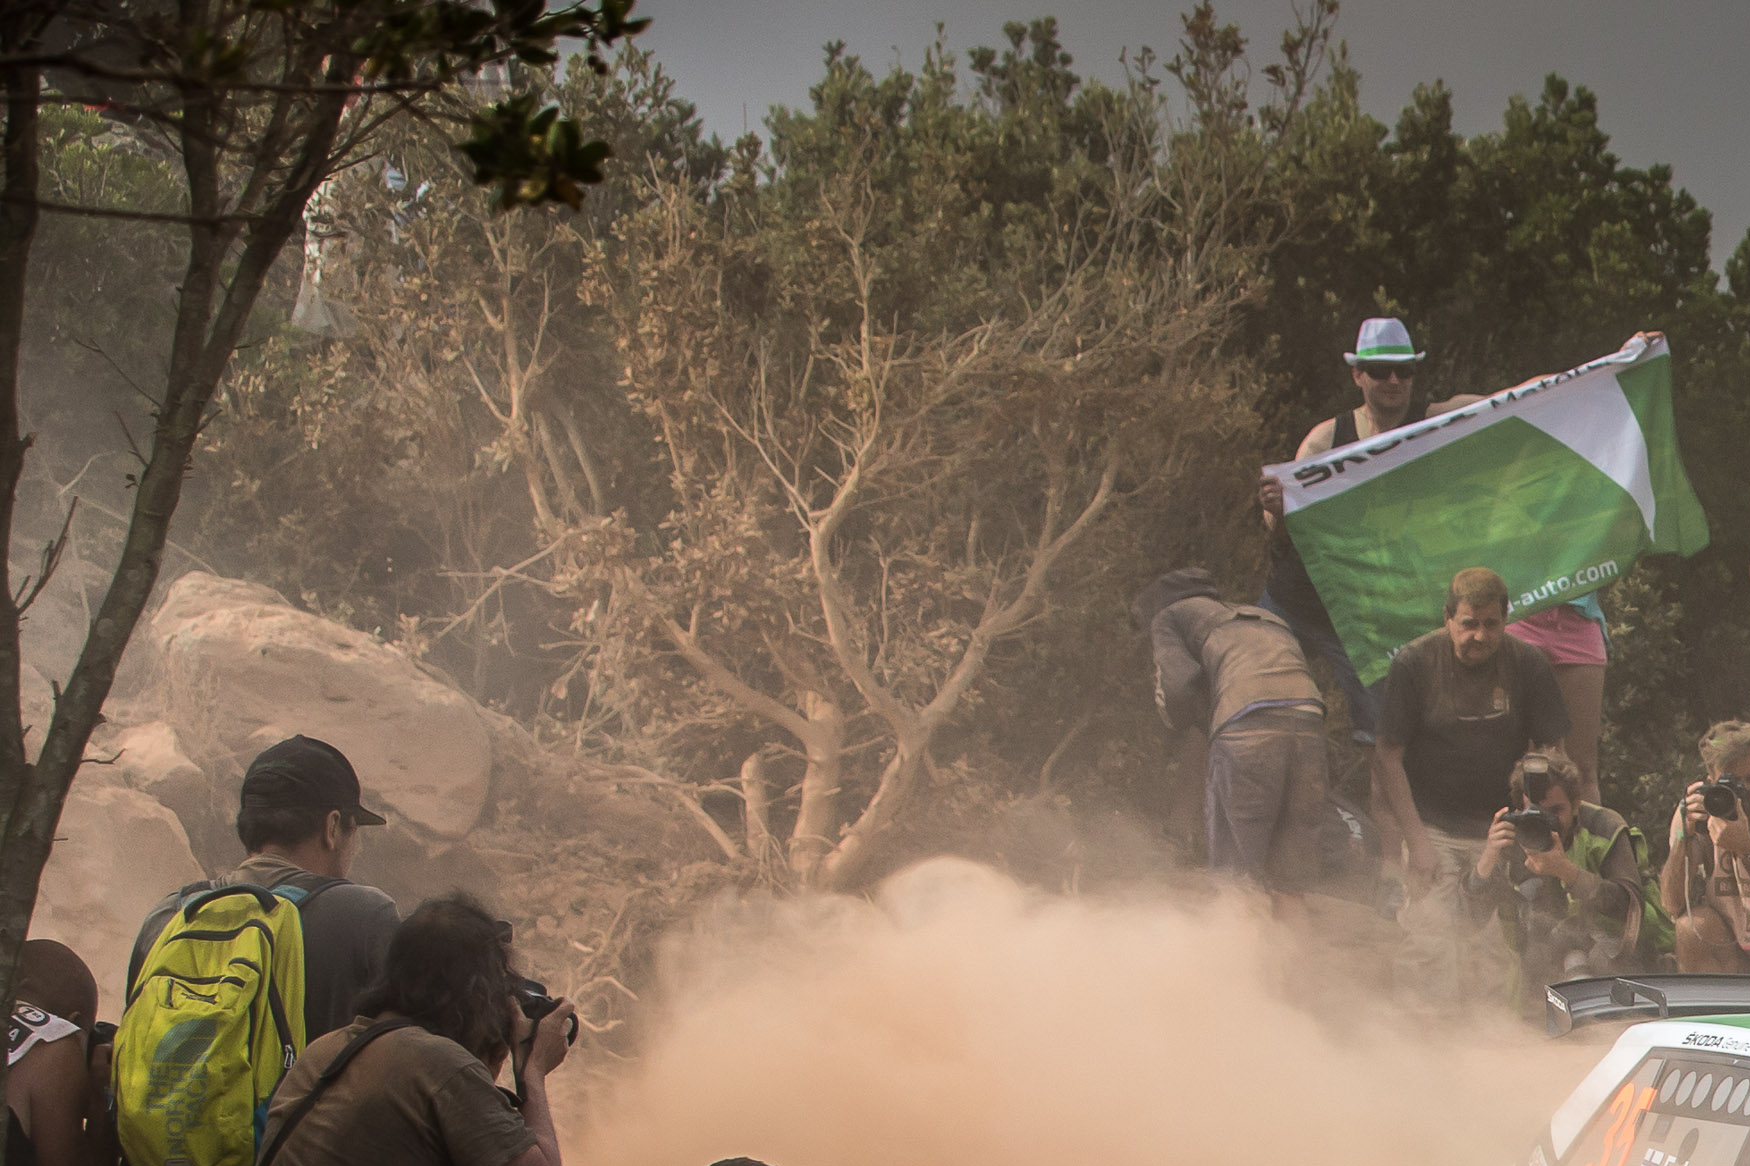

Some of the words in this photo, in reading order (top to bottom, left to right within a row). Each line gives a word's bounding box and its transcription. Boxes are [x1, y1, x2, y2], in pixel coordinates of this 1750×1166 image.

[1682, 1031, 1724, 1048] ŠKODA
[147, 1064, 168, 1114] THE
[165, 1064, 186, 1156] NORTH
[185, 1063, 208, 1129] FACE
